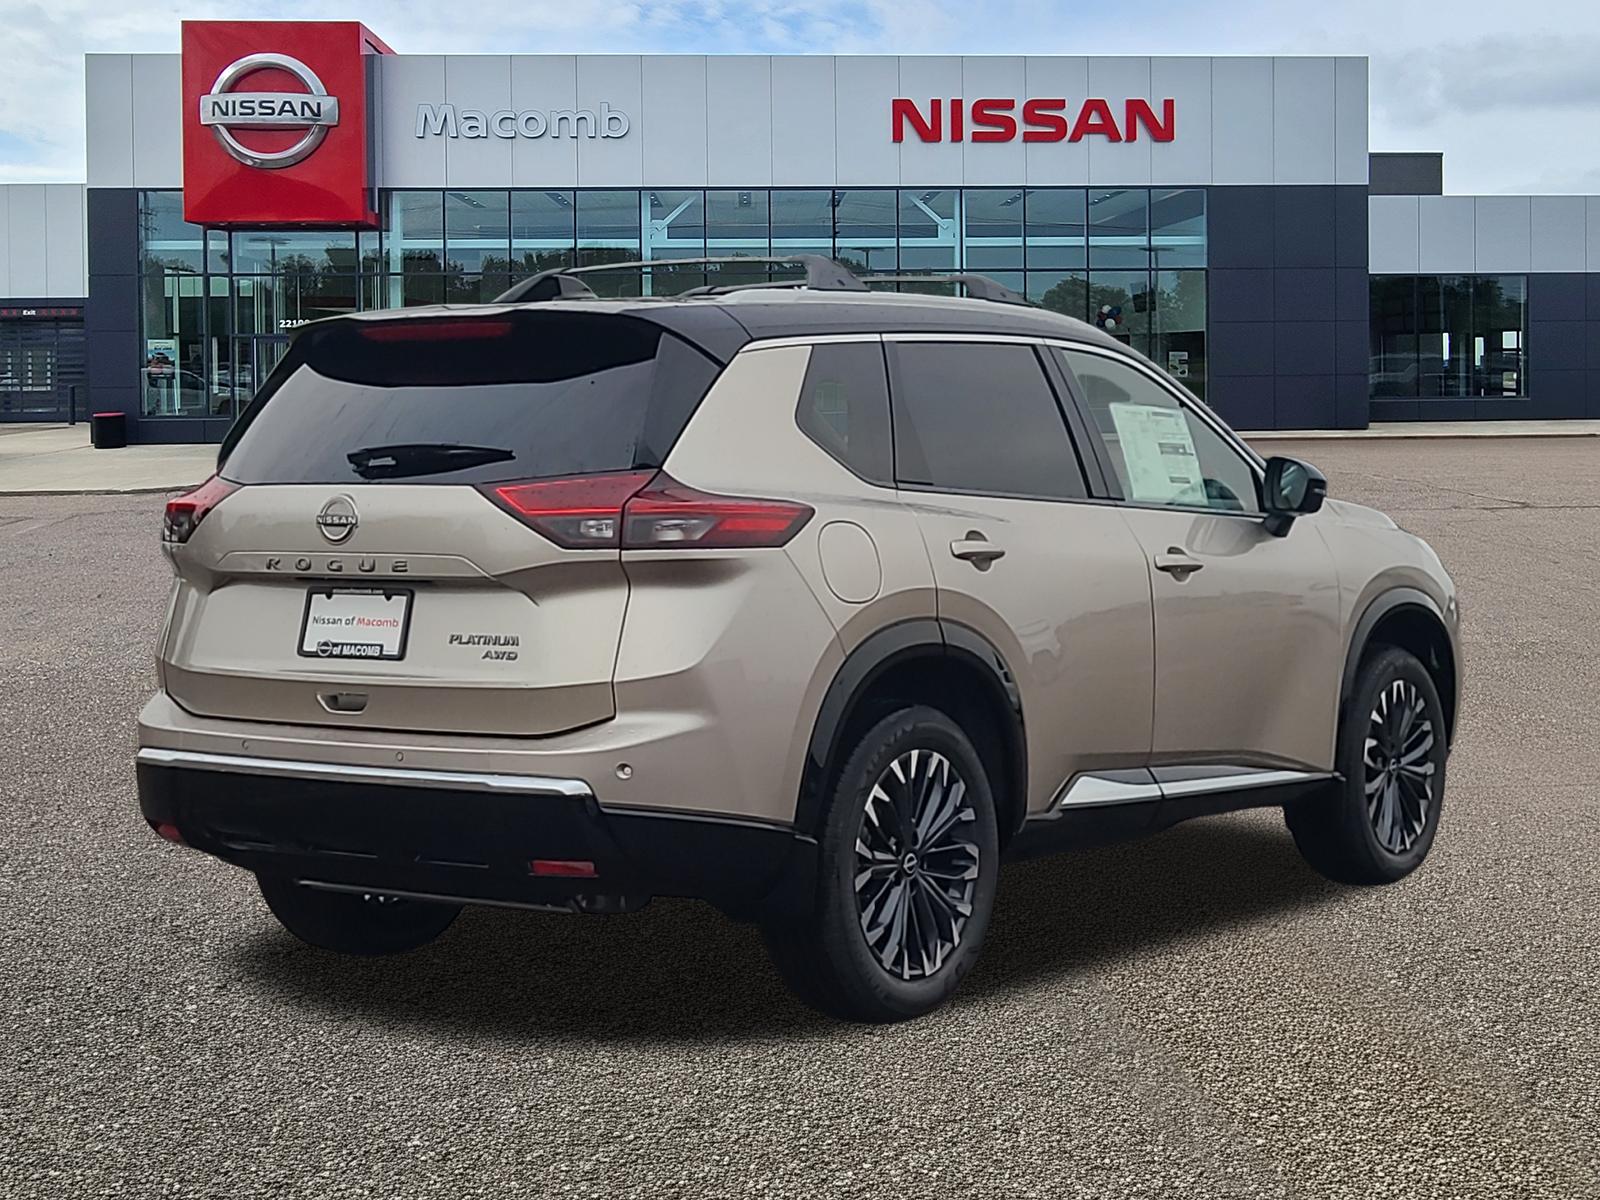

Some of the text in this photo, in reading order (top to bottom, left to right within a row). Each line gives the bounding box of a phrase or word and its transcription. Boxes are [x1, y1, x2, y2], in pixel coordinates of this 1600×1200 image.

[211, 100, 322, 117] NISSAN
[415, 102, 630, 139] Macomb
[892, 98, 1175, 143] NISSAN
[316, 515, 357, 525] NISSAN
[265, 558, 409, 573] ROGUE
[312, 616, 400, 628] Nissan of Macomb
[448, 634, 520, 647] PLATINUM
[332, 644, 382, 656] of MACOMB
[481, 650, 519, 661] AWD
